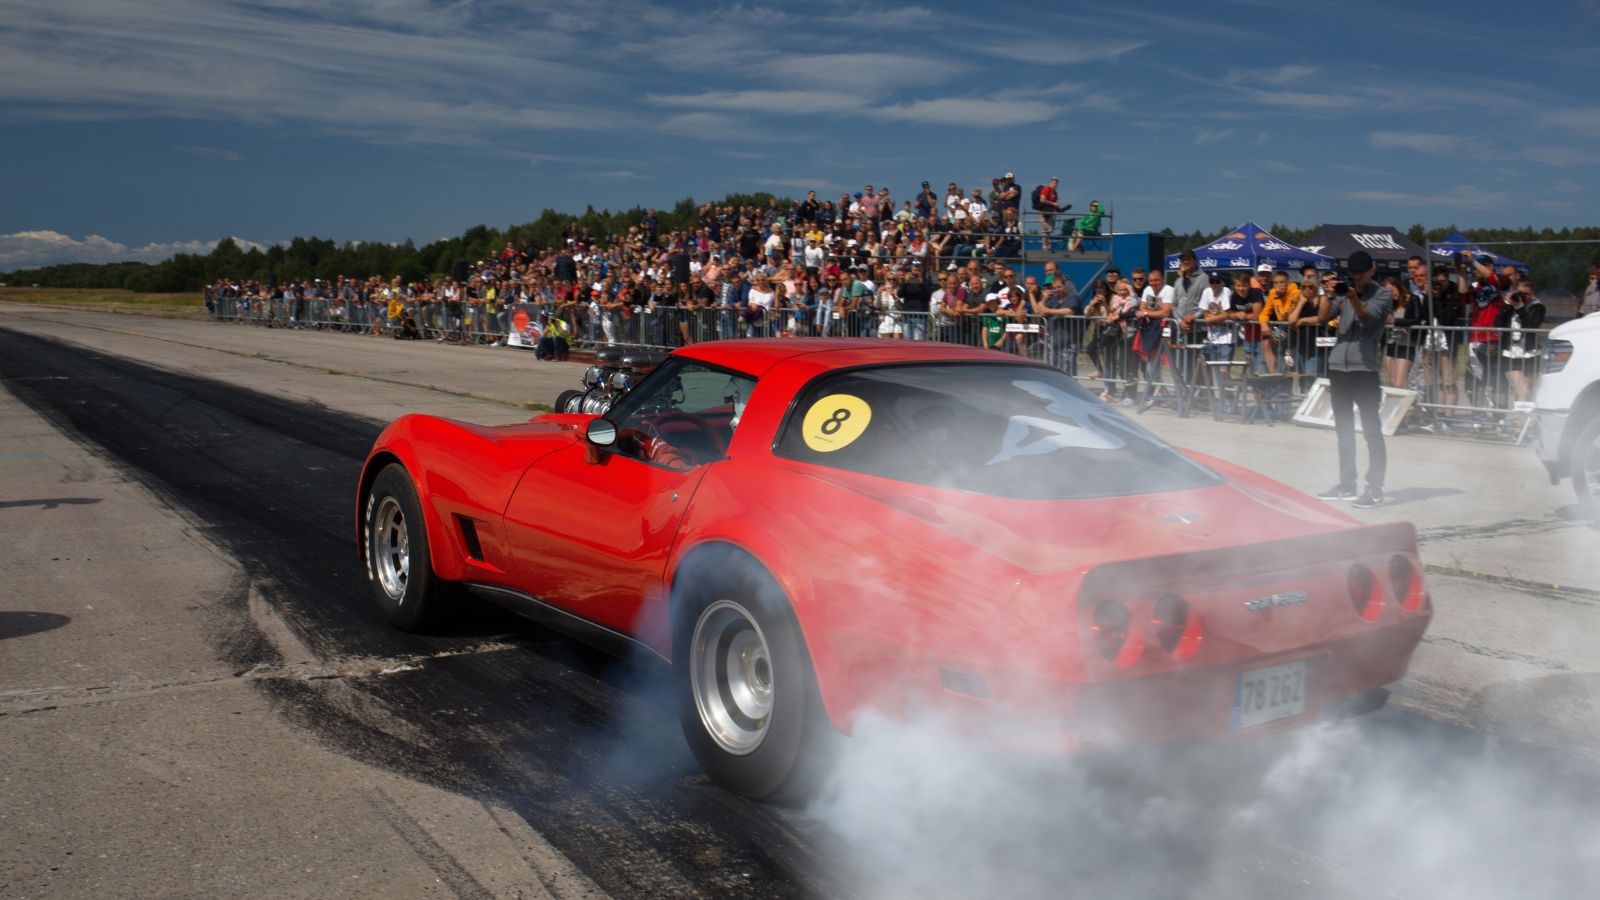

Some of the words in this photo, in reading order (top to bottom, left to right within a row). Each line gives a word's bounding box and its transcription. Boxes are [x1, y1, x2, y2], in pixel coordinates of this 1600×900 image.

[1350, 233, 1407, 250] ROCK
[821, 408, 851, 435] 8
[1244, 679, 1266, 714] 78
